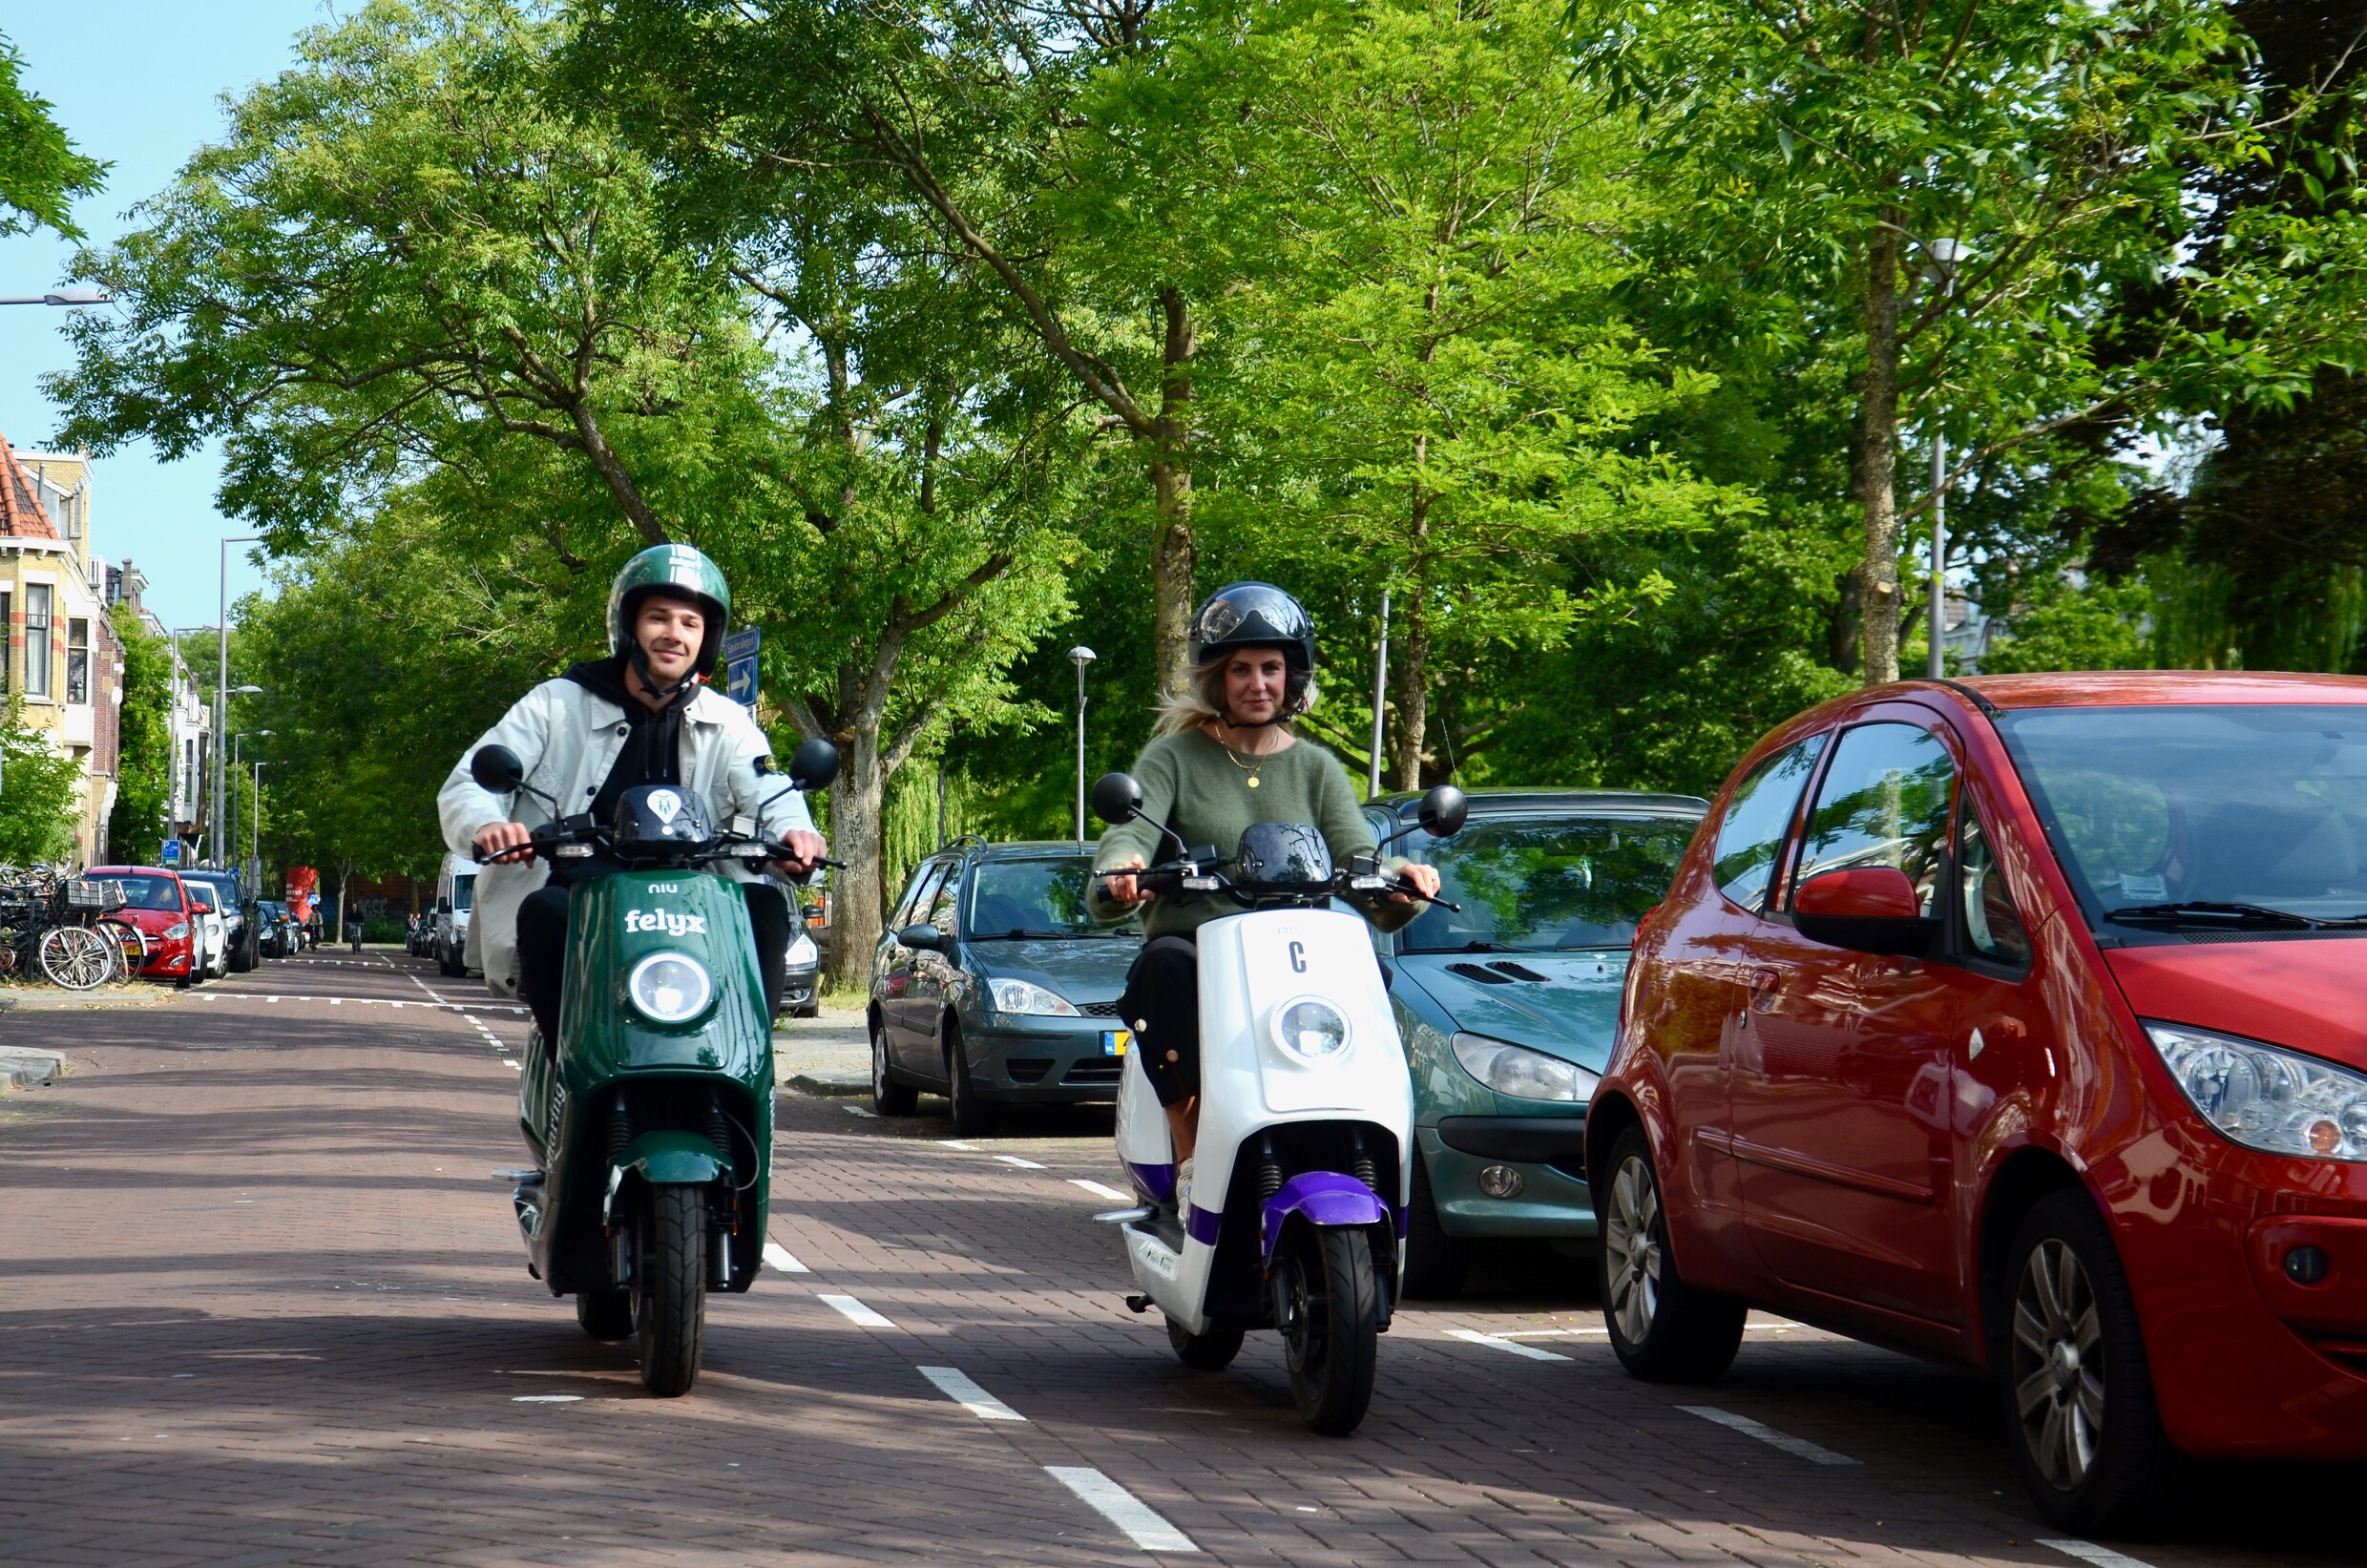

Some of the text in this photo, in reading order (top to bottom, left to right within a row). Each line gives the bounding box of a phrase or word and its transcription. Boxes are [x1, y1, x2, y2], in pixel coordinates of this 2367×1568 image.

[163, 841, 170, 849] P
[624, 909, 706, 937] felyx
[1288, 941, 1308, 973] C
